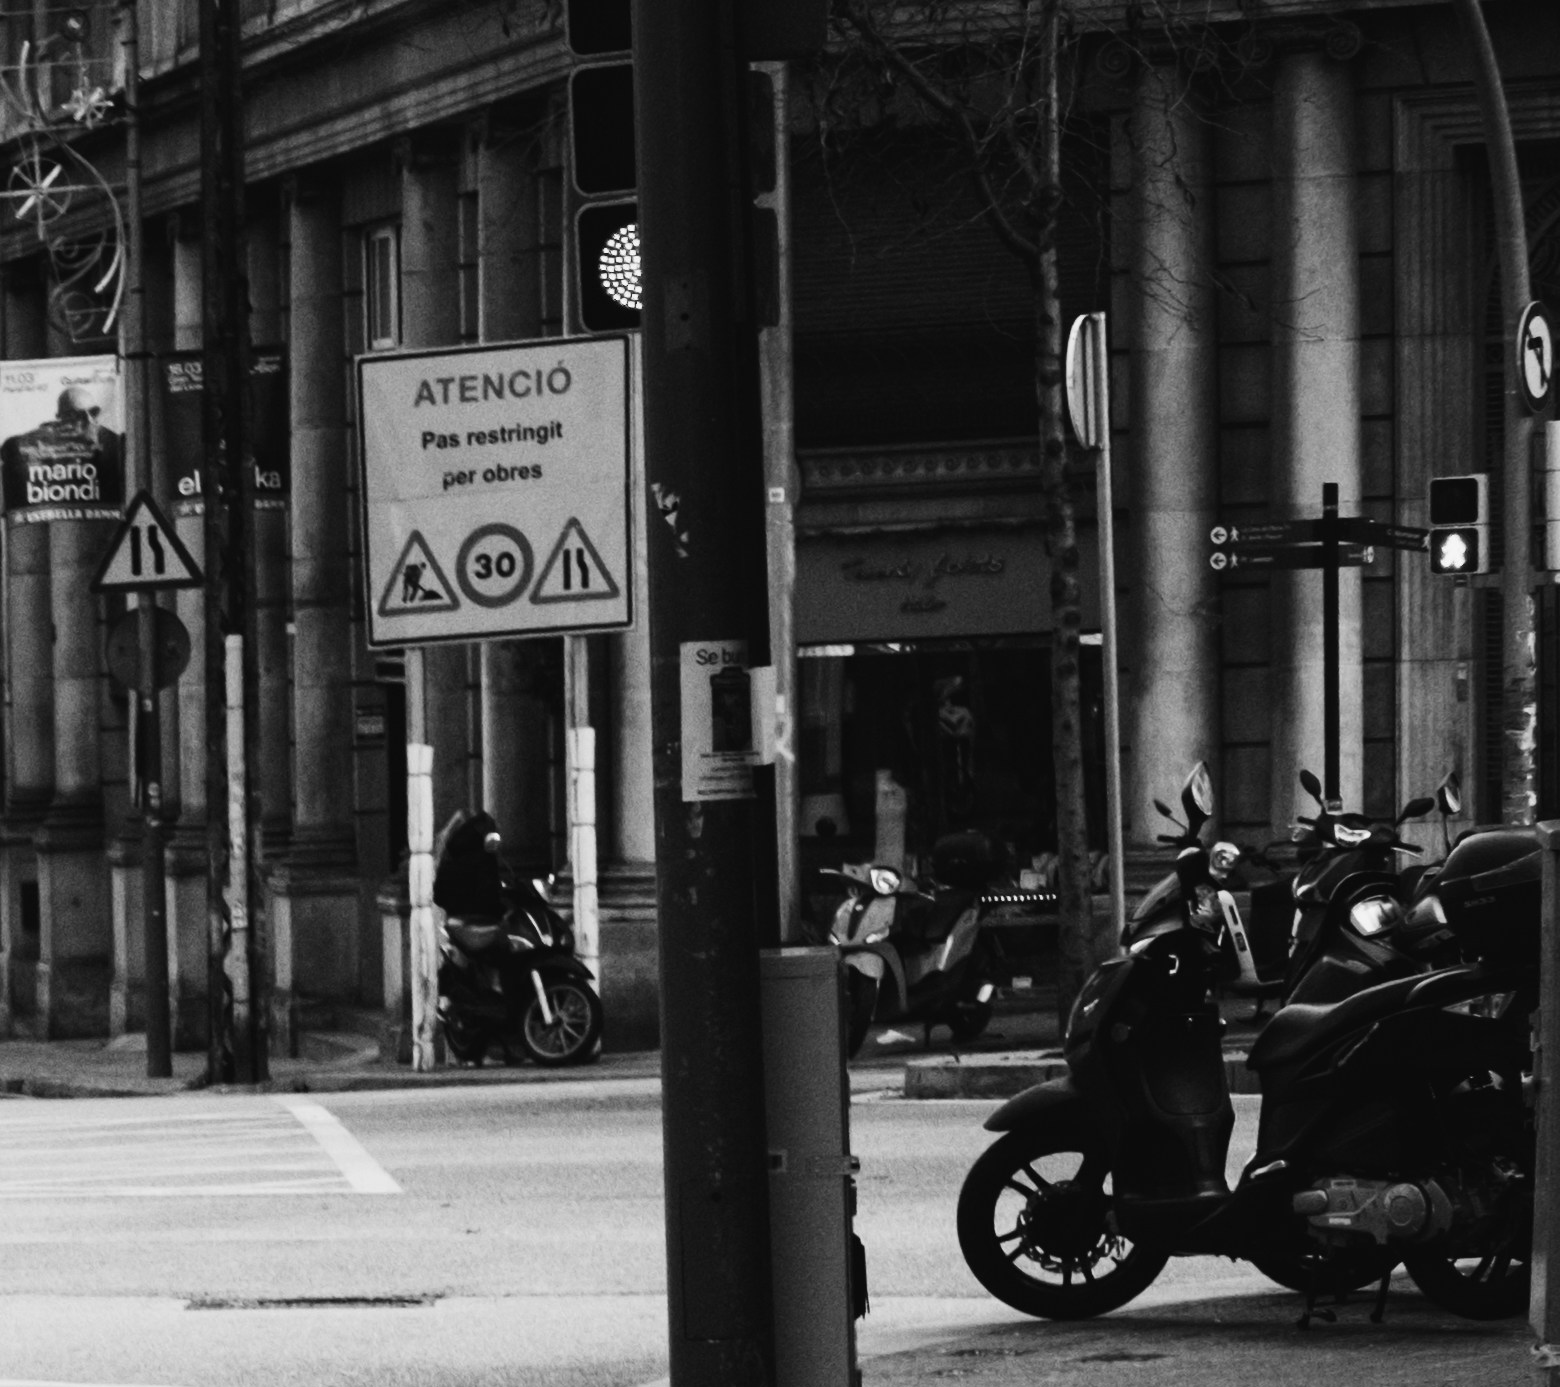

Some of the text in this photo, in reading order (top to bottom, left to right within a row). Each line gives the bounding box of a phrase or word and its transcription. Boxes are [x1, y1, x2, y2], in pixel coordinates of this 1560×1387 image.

[413, 359, 572, 408] ATENCIÓ
[421, 420, 563, 450] Pas restringit
[28, 458, 97, 483] mario
[442, 462, 543, 491] per obres
[26, 480, 99, 504] biondi
[474, 550, 516, 579] 30
[695, 648, 719, 666] Se
